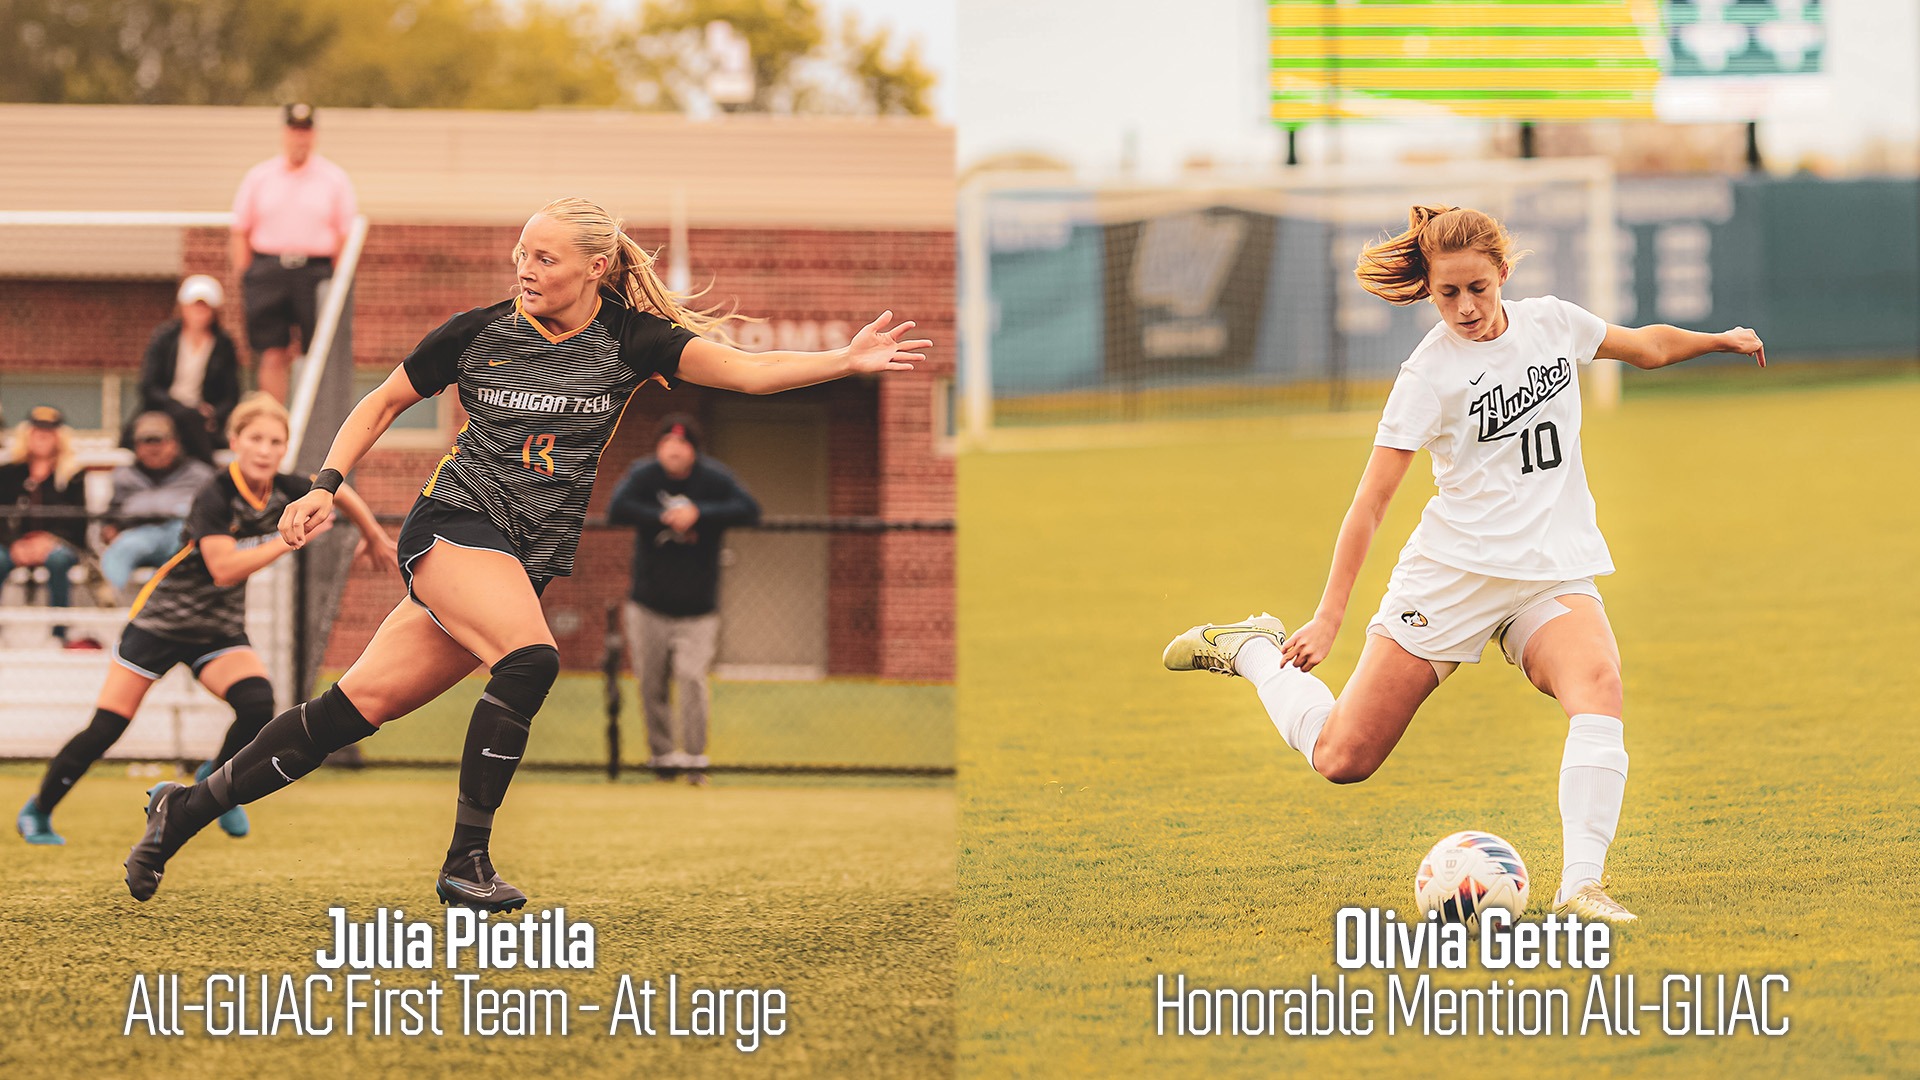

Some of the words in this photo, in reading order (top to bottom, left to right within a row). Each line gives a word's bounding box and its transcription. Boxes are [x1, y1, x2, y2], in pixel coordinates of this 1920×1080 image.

[477, 387, 568, 413] MICHIGAN
[572, 393, 611, 414] TECH
[1468, 357, 1572, 442] Huskies
[521, 433, 557, 477] 13
[1519, 420, 1562, 475] 10
